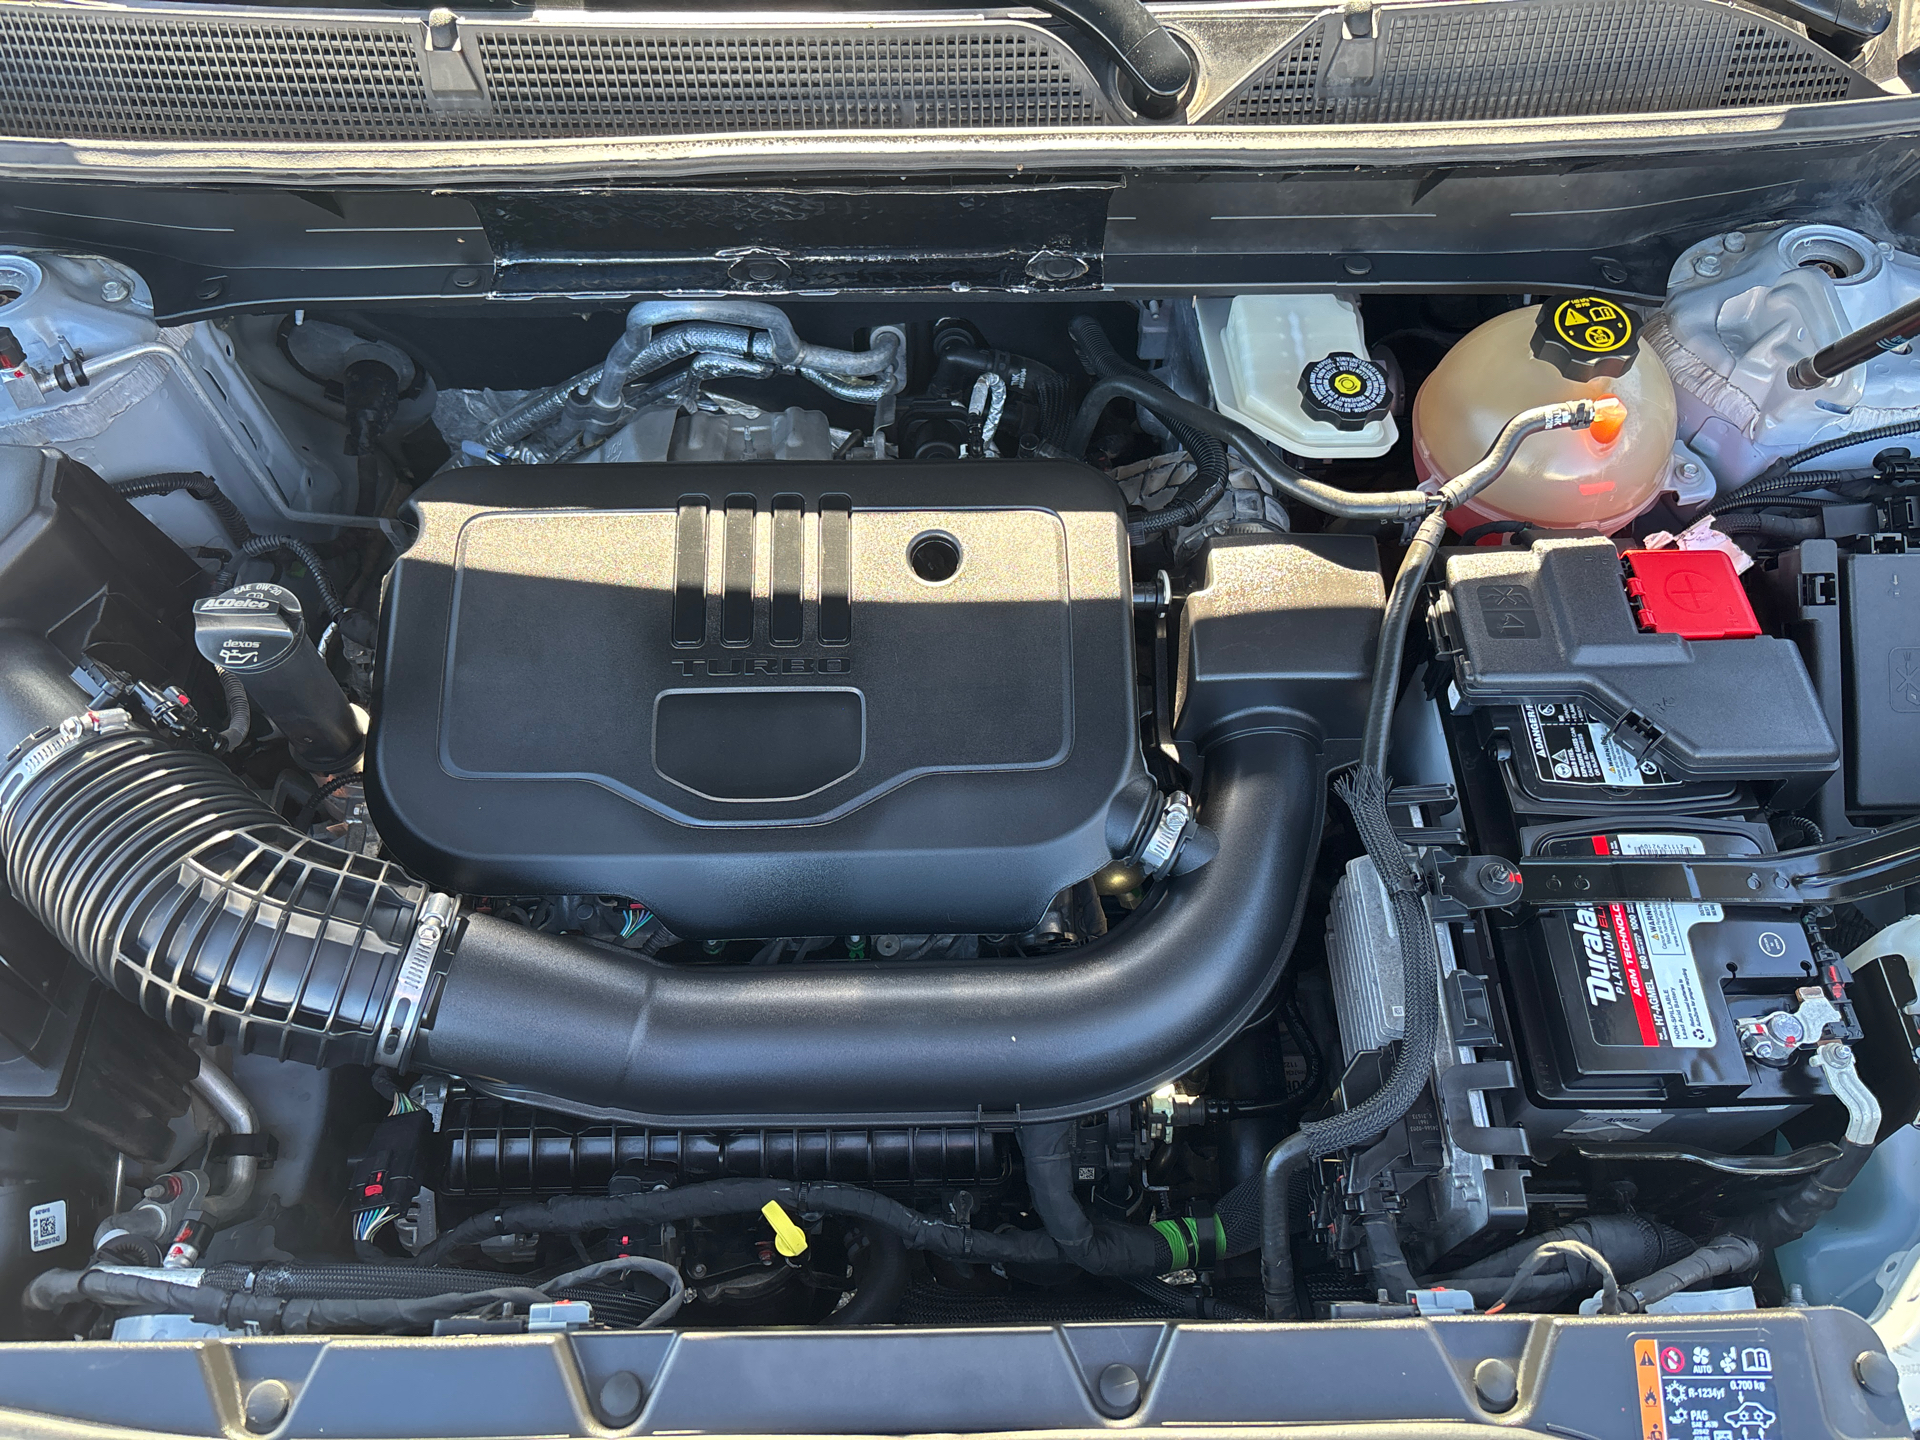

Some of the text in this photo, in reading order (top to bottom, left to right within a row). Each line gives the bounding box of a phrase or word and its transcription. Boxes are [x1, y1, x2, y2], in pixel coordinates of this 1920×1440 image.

[234, 584, 282, 596] SAE 0W-20
[200, 599, 270, 610] ACDelco
[223, 640, 260, 648] dexos
[672, 658, 850, 676] TURBO
[1629, 914, 1639, 930] 1000
[1644, 904, 1657, 932] WARNIN
[1573, 902, 1616, 1006] Durala
[1602, 930, 1626, 995] PLATINUM
[1639, 956, 1650, 970] 850
[1628, 968, 1642, 997] AGM
[1645, 979, 1664, 1026] H7-AGMEL
[1663, 989, 1681, 1039] NON-SPILLABLE
[1670, 987, 1688, 1039] Lead Acid Battery
[1693, 1365, 1713, 1374] AUTO
[1688, 1388, 1725, 1400] R-1234yf
[1730, 1380, 1765, 1392] 0.700 kg
[1690, 1410, 1709, 1421] PAG
